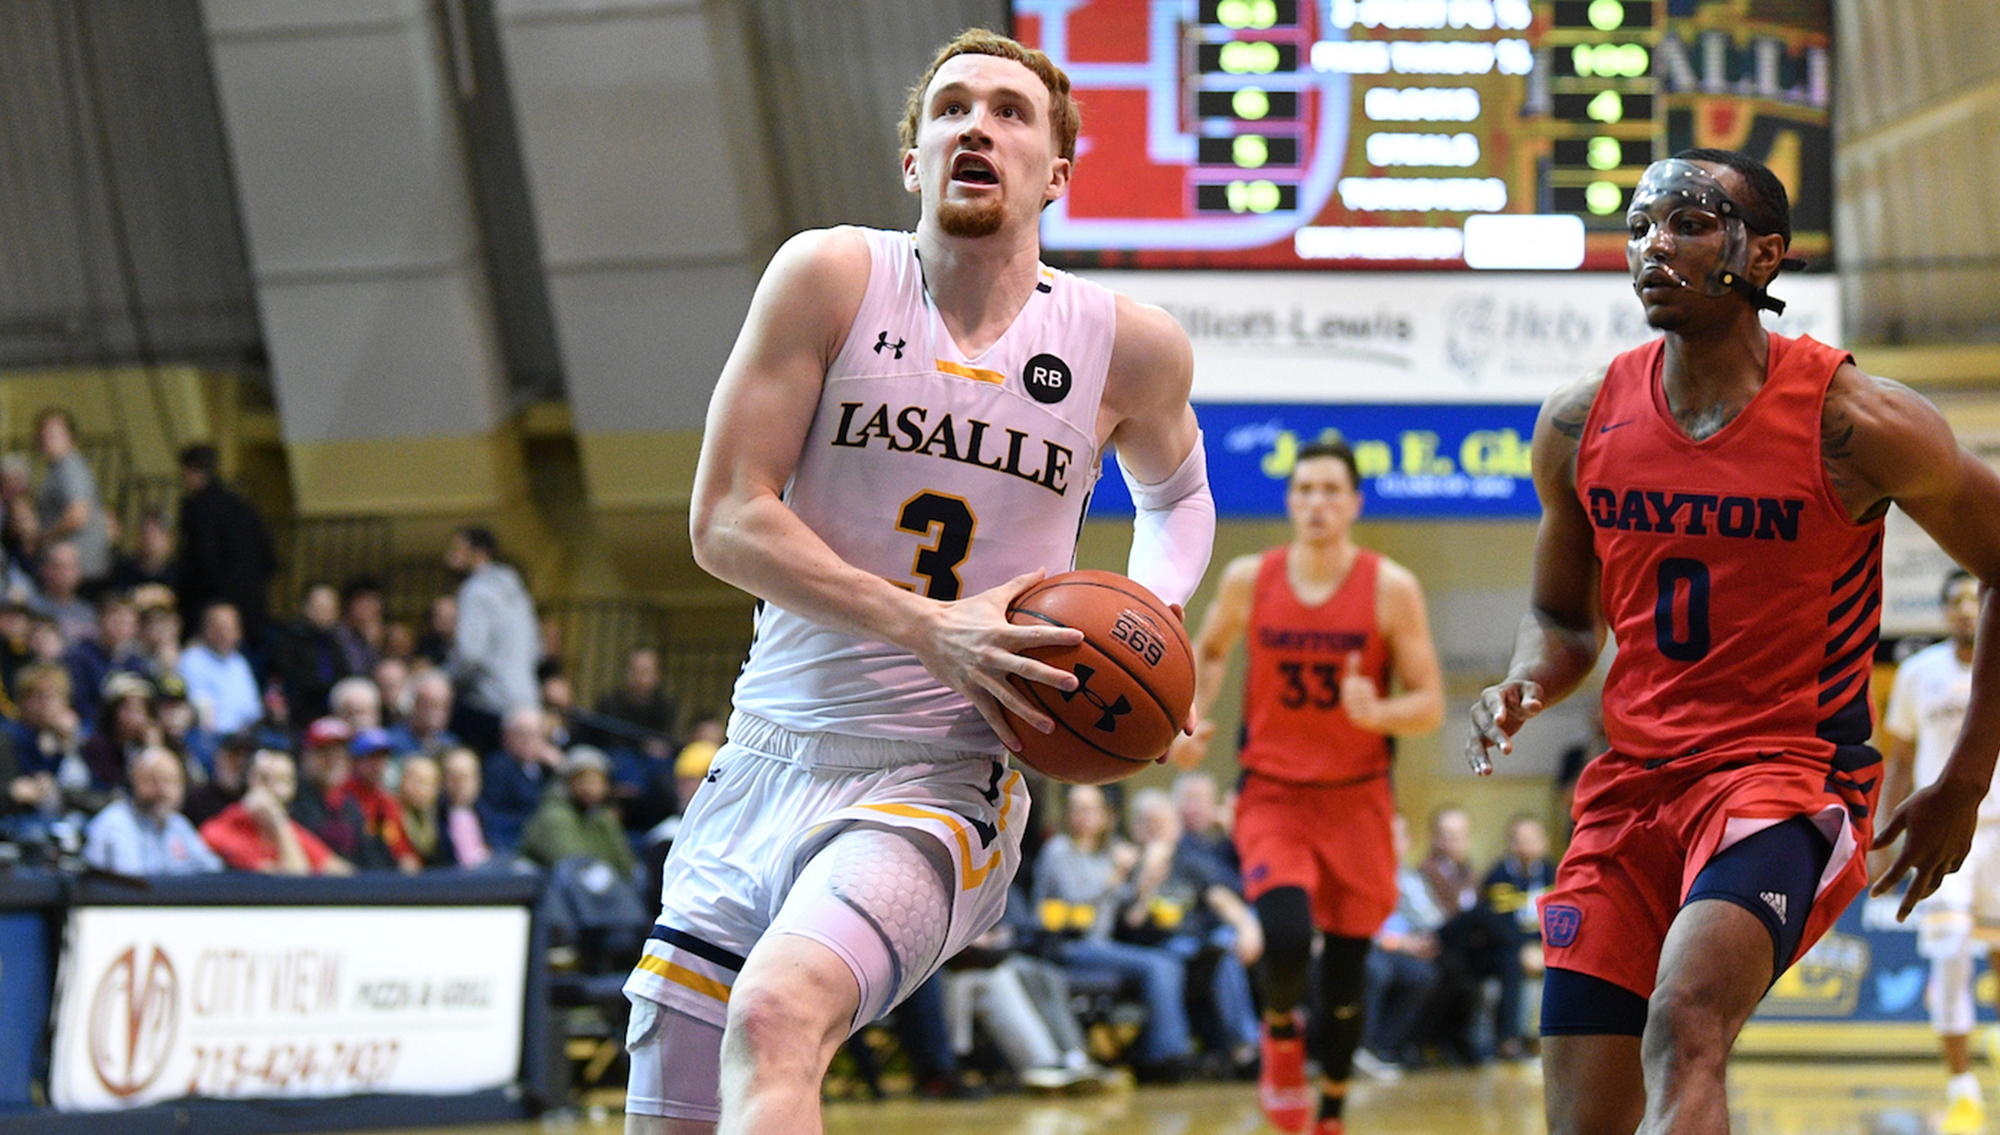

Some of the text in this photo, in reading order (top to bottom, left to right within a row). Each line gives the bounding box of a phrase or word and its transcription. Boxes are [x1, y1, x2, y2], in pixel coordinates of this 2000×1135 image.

[1033, 366, 1063, 389] RB
[1588, 486, 1804, 541] DAYTON
[881, 488, 978, 601] 3
[1654, 557, 1710, 661] 0
[1279, 662, 1341, 711] 33
